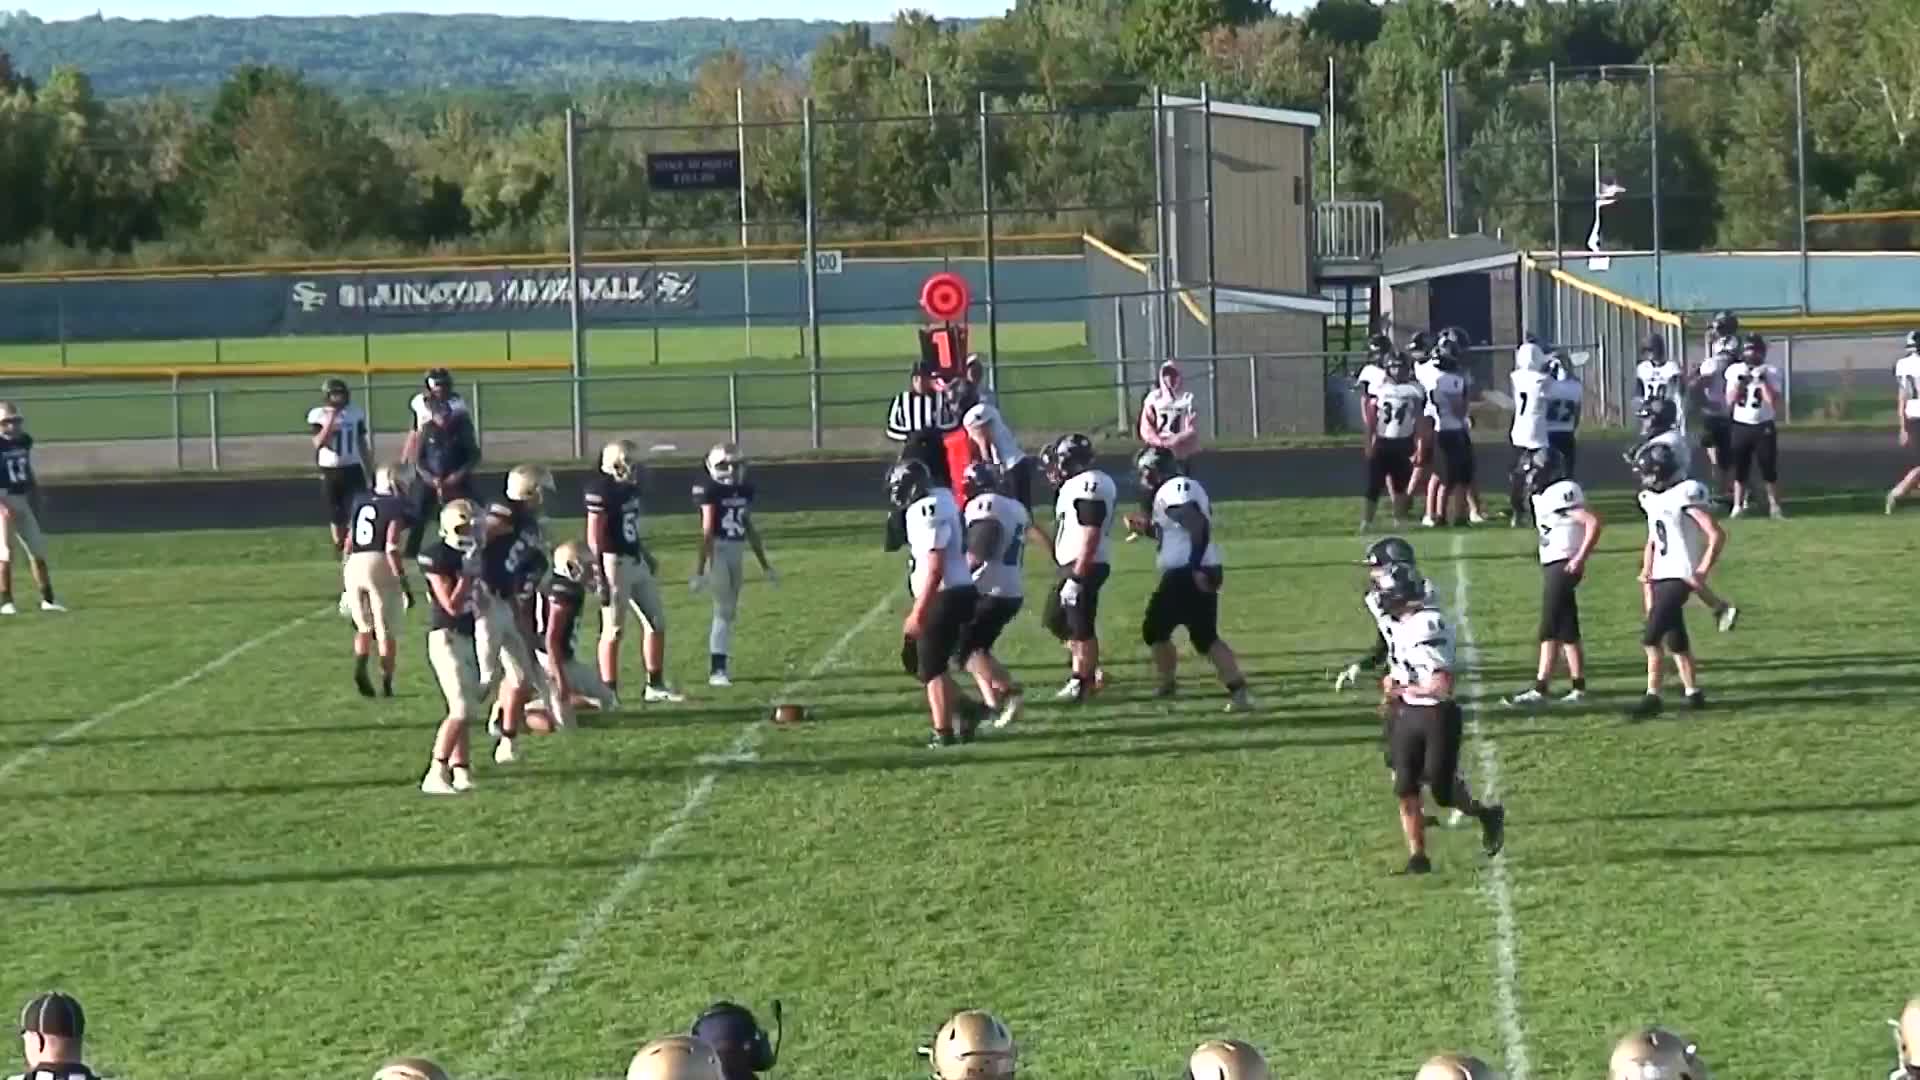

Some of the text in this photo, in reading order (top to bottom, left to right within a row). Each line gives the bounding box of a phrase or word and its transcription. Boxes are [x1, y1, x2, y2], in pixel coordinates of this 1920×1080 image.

[932, 330, 951, 369] 1
[355, 504, 377, 546] 6
[1654, 519, 1669, 557] 9
